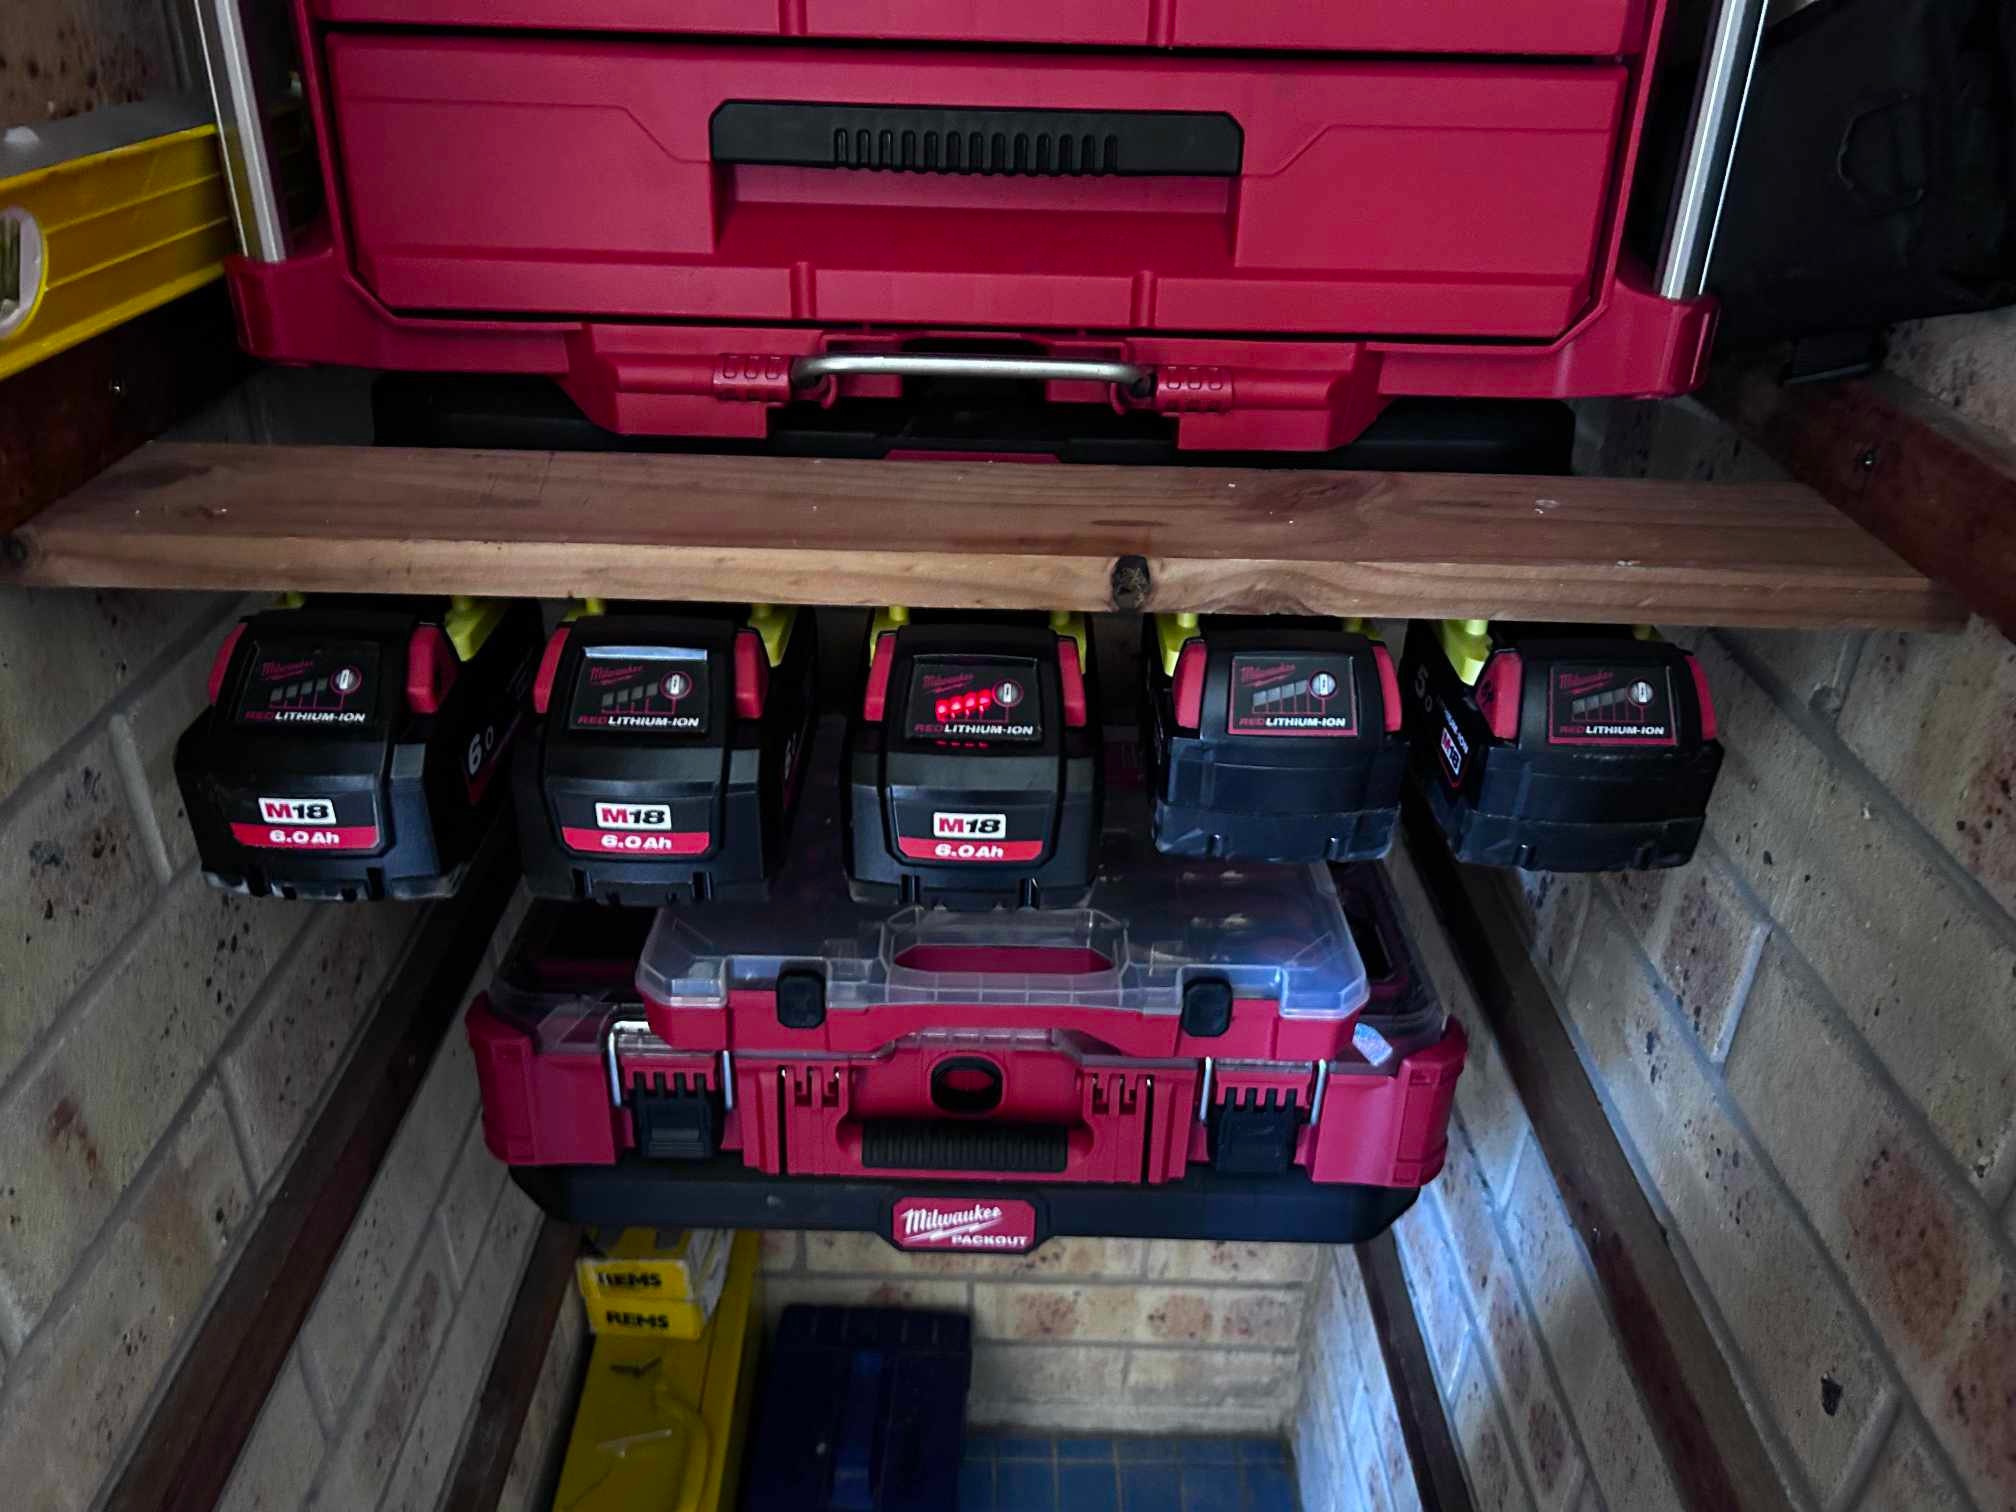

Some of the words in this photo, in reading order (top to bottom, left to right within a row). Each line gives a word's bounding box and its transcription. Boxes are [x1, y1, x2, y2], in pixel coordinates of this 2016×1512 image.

[264, 802, 330, 820] M18
[600, 807, 666, 825] M18
[938, 817, 1001, 834] M18
[901, 1203, 1003, 1235] Milwaukee
[951, 1234, 1028, 1247] PACKOUT
